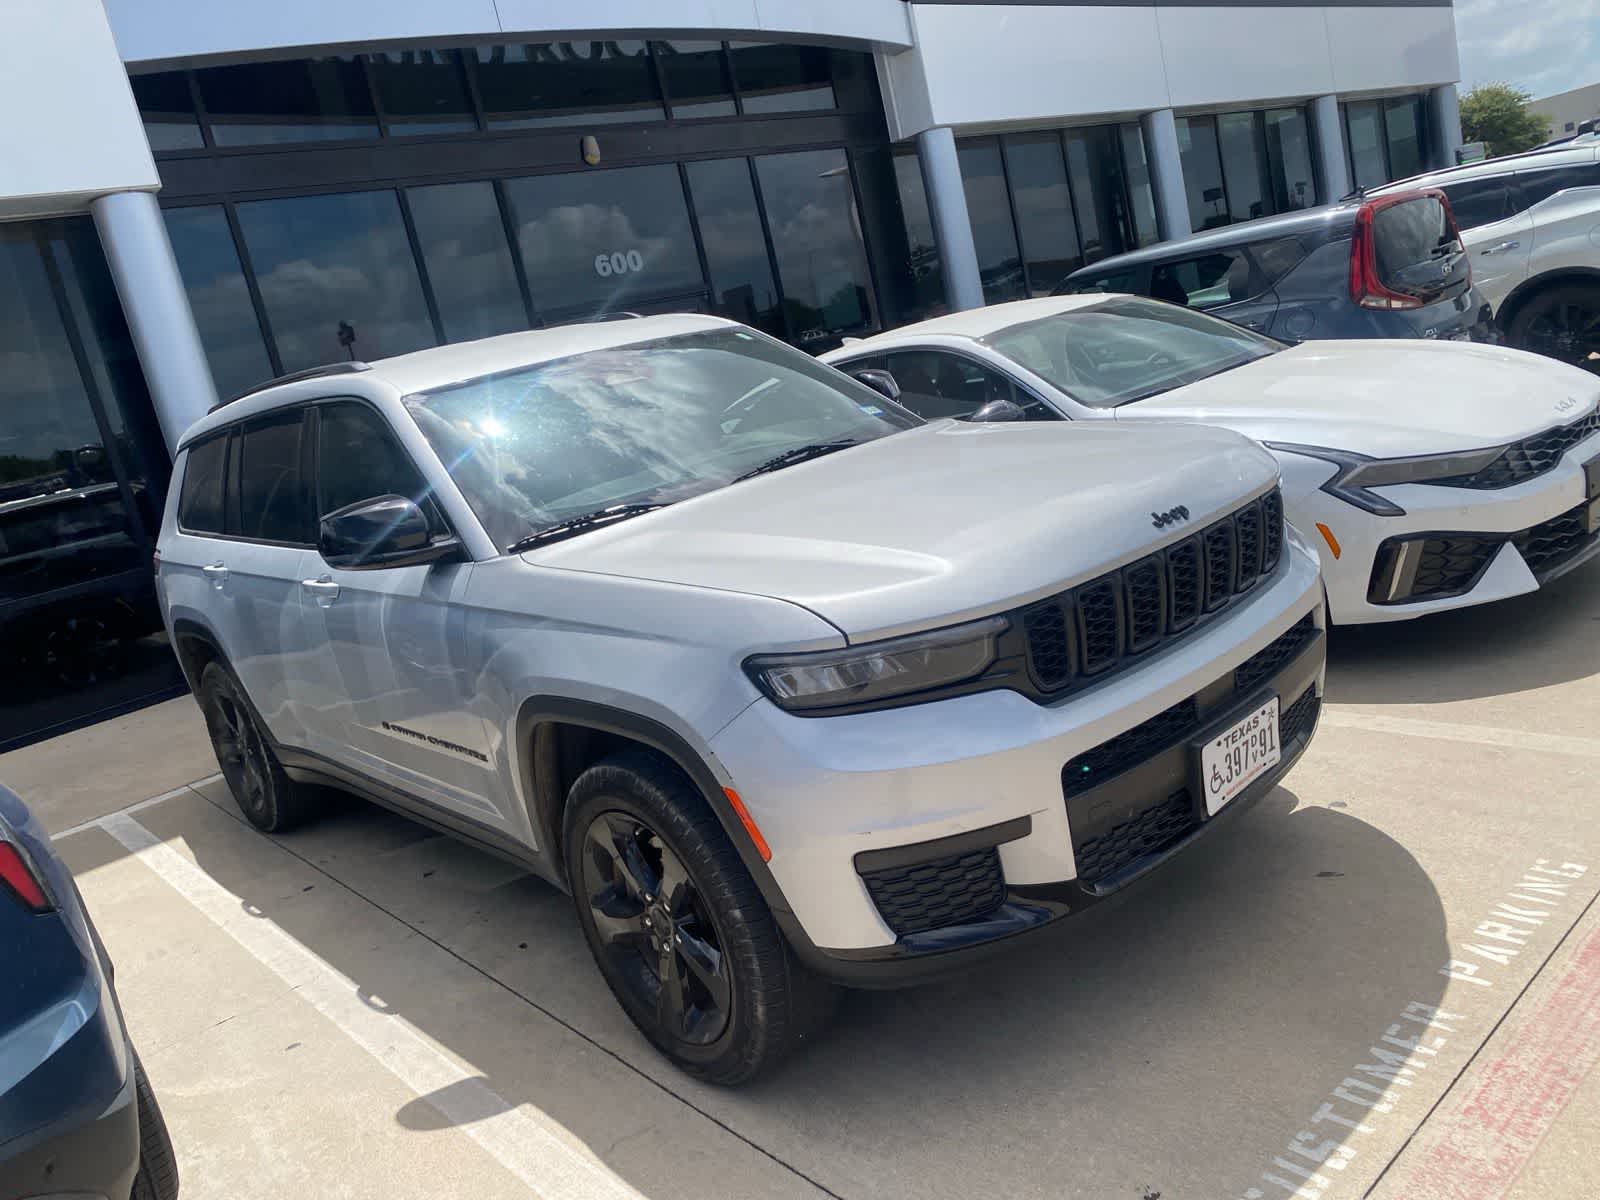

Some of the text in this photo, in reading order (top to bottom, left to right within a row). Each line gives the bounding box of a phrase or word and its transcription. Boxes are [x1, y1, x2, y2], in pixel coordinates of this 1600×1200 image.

[595, 250, 643, 277] 600
[1151, 505, 1190, 529] Jeep
[1223, 716, 1260, 748] TEXAS
[1240, 858, 1589, 1200] USTOMER PARKING
